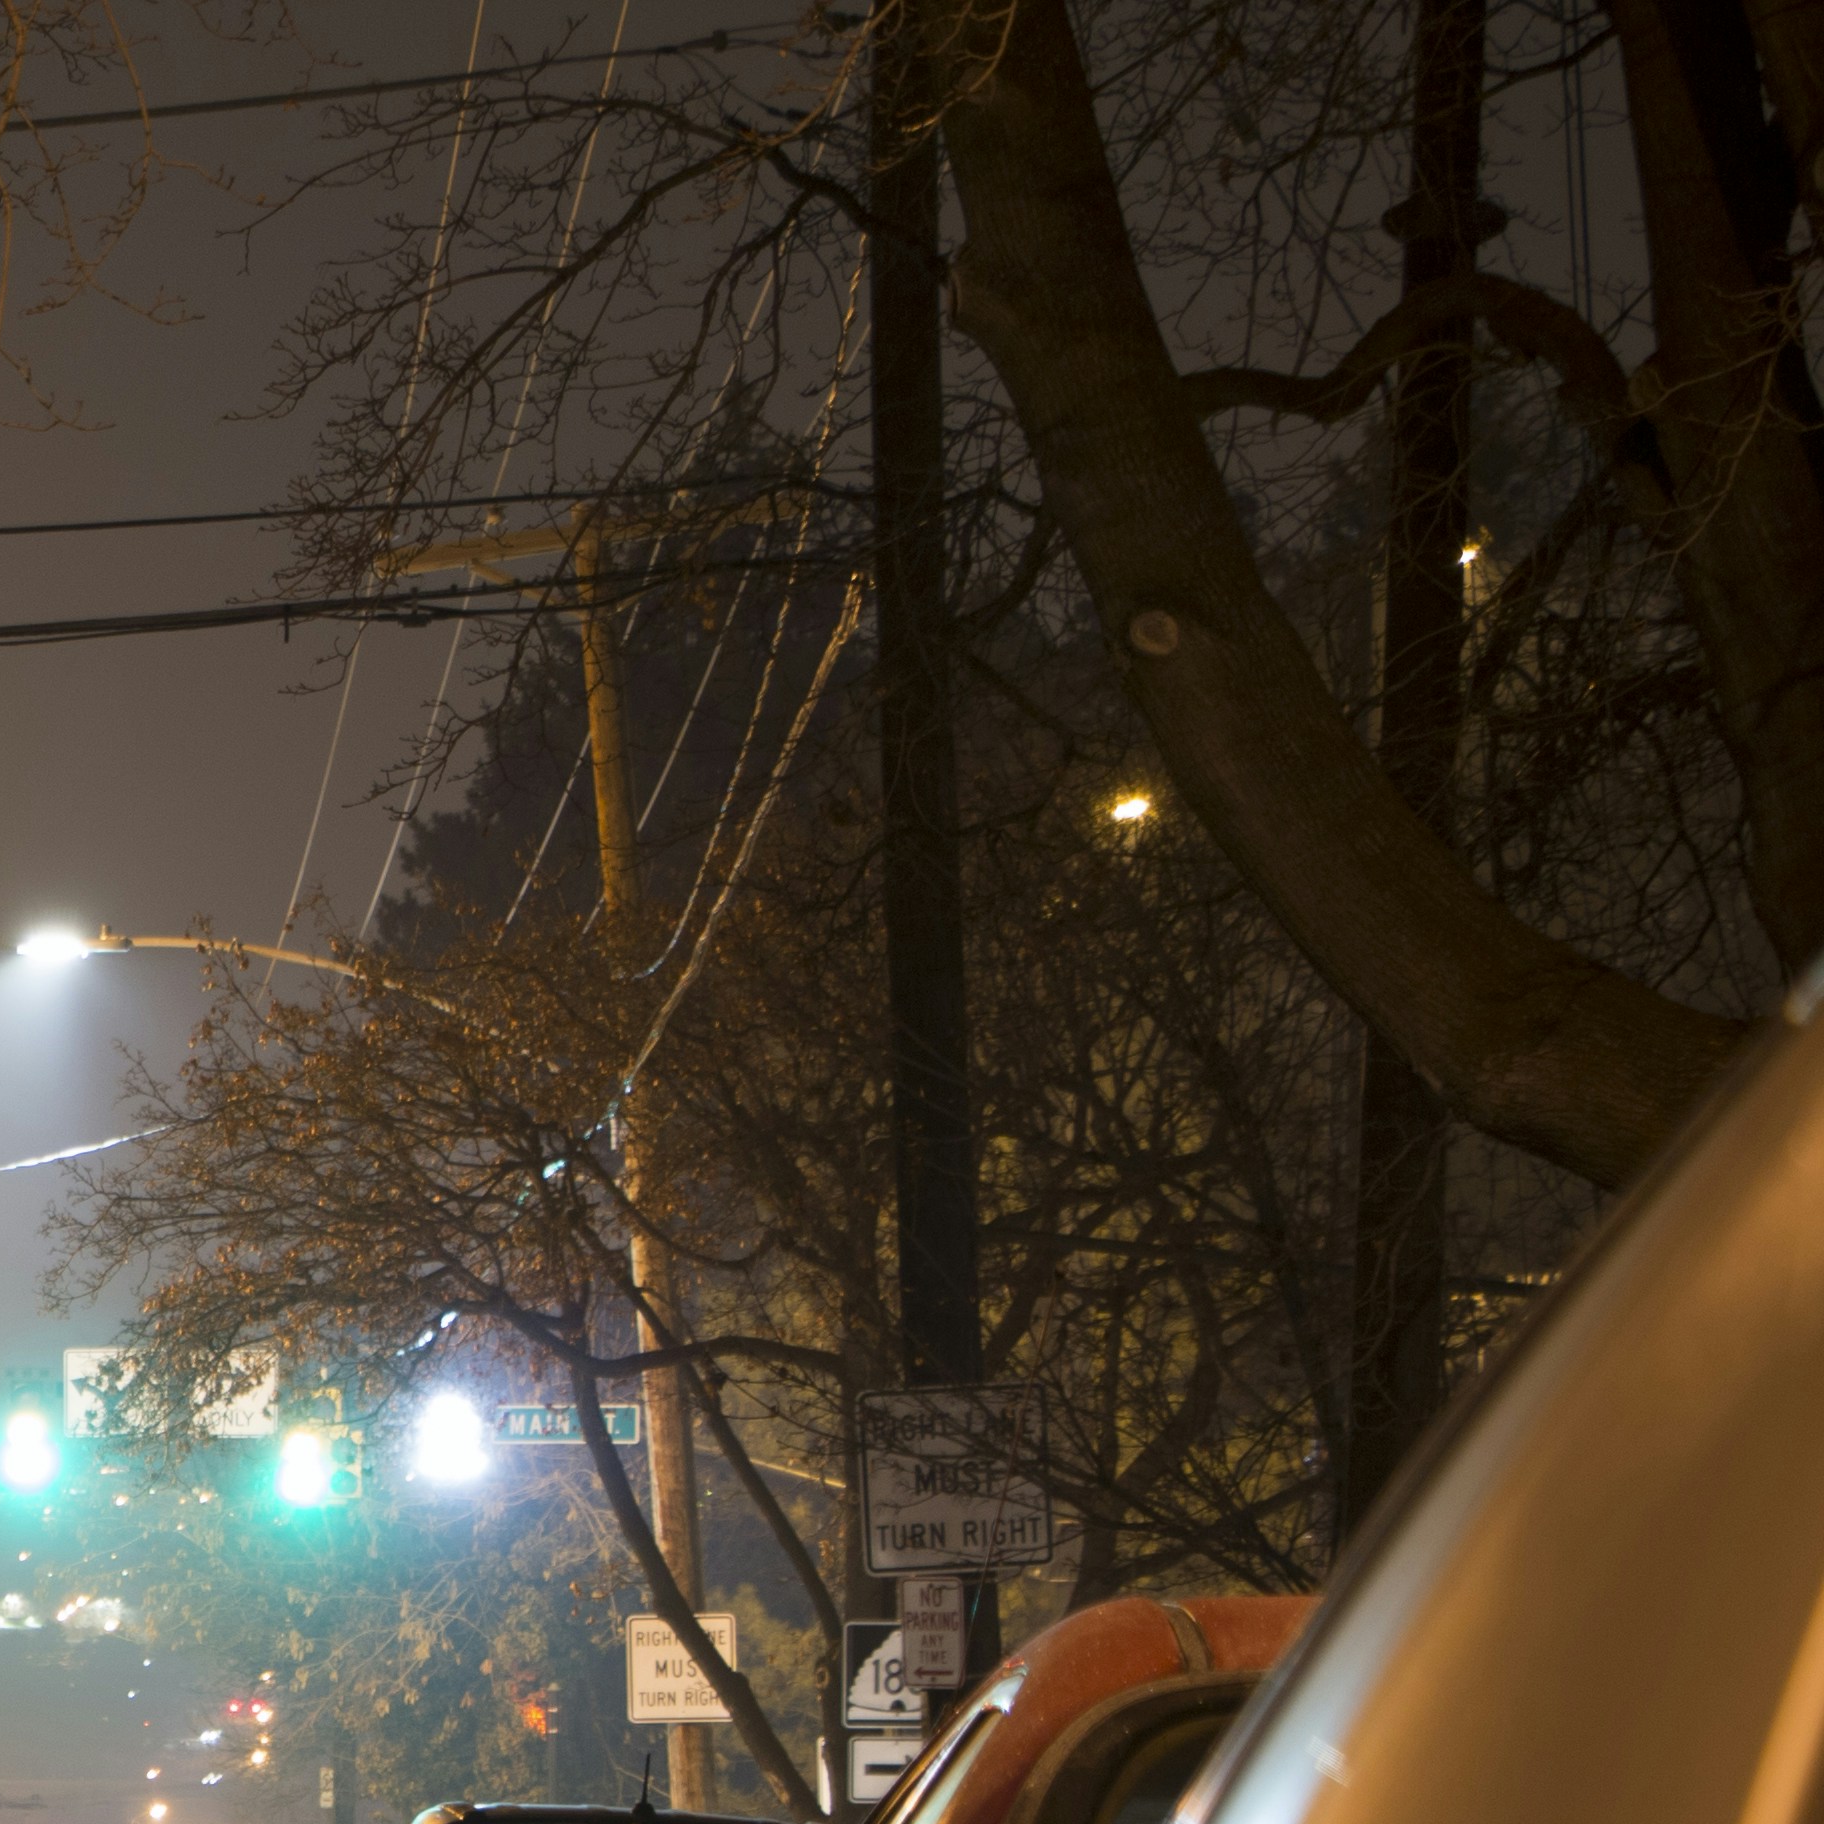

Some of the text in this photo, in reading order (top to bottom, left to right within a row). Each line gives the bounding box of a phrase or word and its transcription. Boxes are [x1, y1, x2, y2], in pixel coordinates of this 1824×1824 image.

[509, 1413, 570, 1435] MAIN
[915, 1461, 996, 1496] MUST
[876, 1517, 1042, 1551] TURN RIGHT
[919, 1585, 944, 1608] NO
[905, 1611, 959, 1631] PARKING
[920, 1634, 944, 1648] ANY
[918, 1650, 947, 1664] TIME
[655, 1659, 697, 1678] MUS
[872, 1658, 922, 1695] 18
[639, 1690, 720, 1707] TURN RIGH
